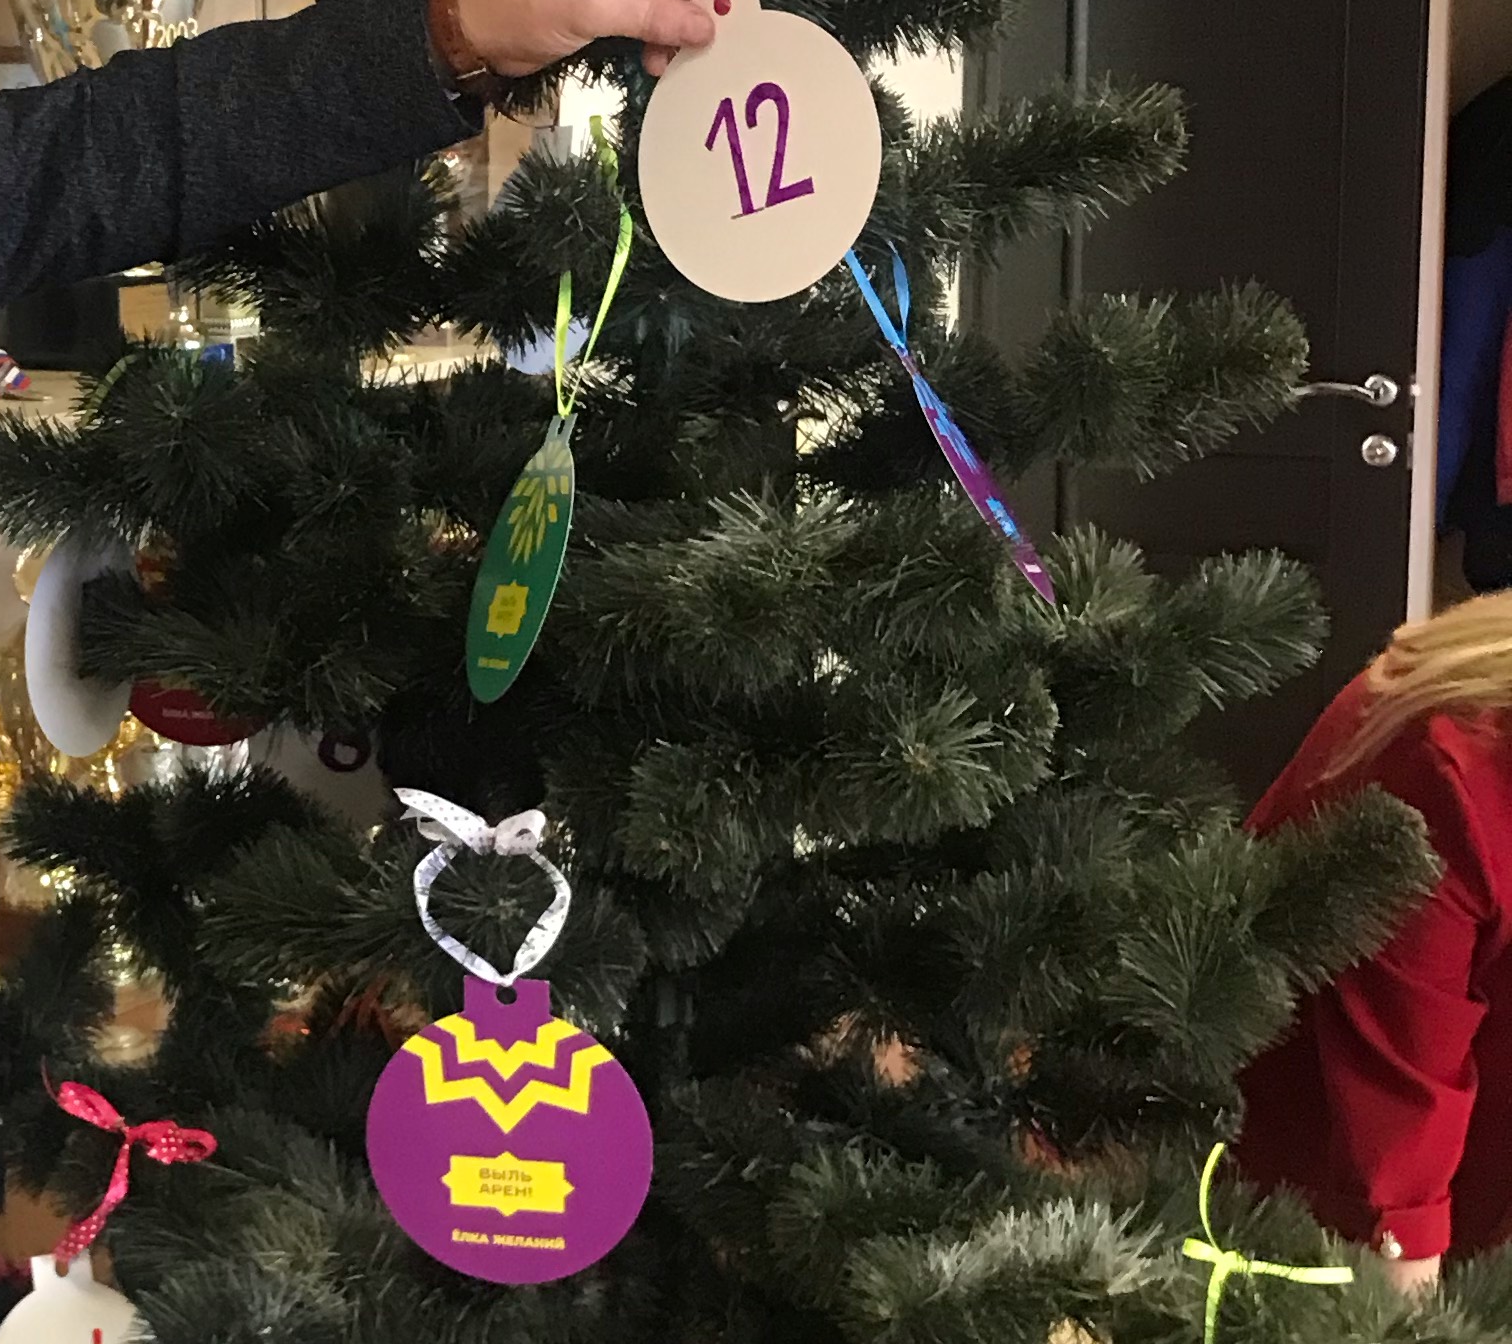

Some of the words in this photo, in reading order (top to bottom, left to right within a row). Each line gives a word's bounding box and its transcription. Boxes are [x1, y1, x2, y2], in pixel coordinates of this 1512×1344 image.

[704, 81, 815, 216] 12
[478, 1167, 533, 1183] ВЫЛЬ
[478, 1183, 534, 1198] АРЕН!
[452, 1228, 490, 1245] ЁЛКА
[492, 1233, 566, 1251] ЖЕЛАНИЙ
